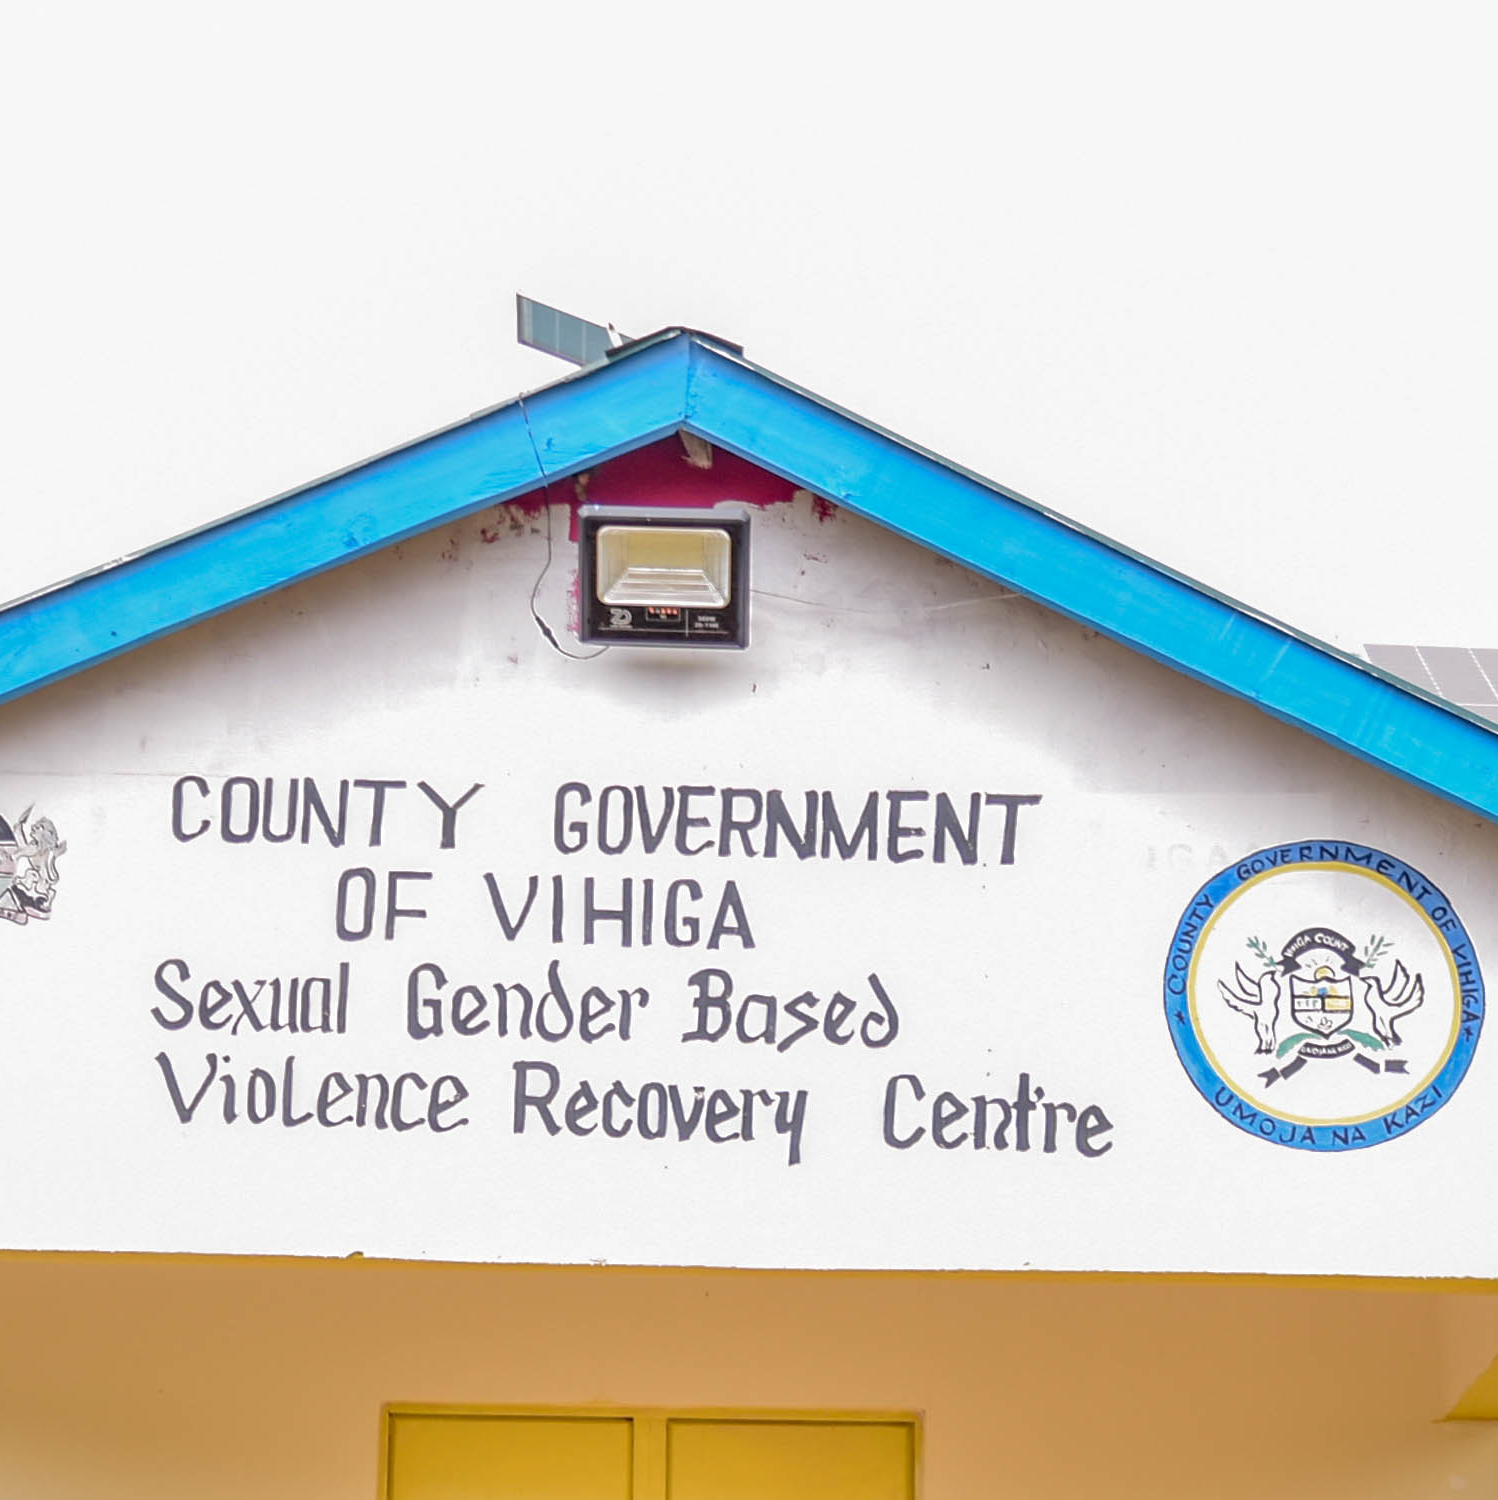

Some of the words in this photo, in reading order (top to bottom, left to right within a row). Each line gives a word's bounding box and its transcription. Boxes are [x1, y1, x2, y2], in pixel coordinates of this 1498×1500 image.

[172, 775, 485, 850] COUNTY
[554, 781, 1043, 866] GOVERNMENT
[336, 867, 433, 942] OF
[483, 872, 756, 950] VIHIGA
[1167, 893, 1214, 996] COUNTY
[1236, 845, 1432, 901] GOVERNMENT
[1431, 906, 1457, 932] OF
[1452, 943, 1481, 1023] VIHIGA
[150, 958, 350, 1036] Sexual
[407, 959, 650, 1044] Gender
[681, 968, 899, 1053] Based
[154, 1051, 470, 1133] Violence
[512, 1060, 809, 1167] Recovery
[883, 1072, 1114, 1158] Centre
[1214, 1086, 1316, 1145] UMOJA
[1332, 1125, 1366, 1146] NA
[1383, 1084, 1443, 1135] KAZI
